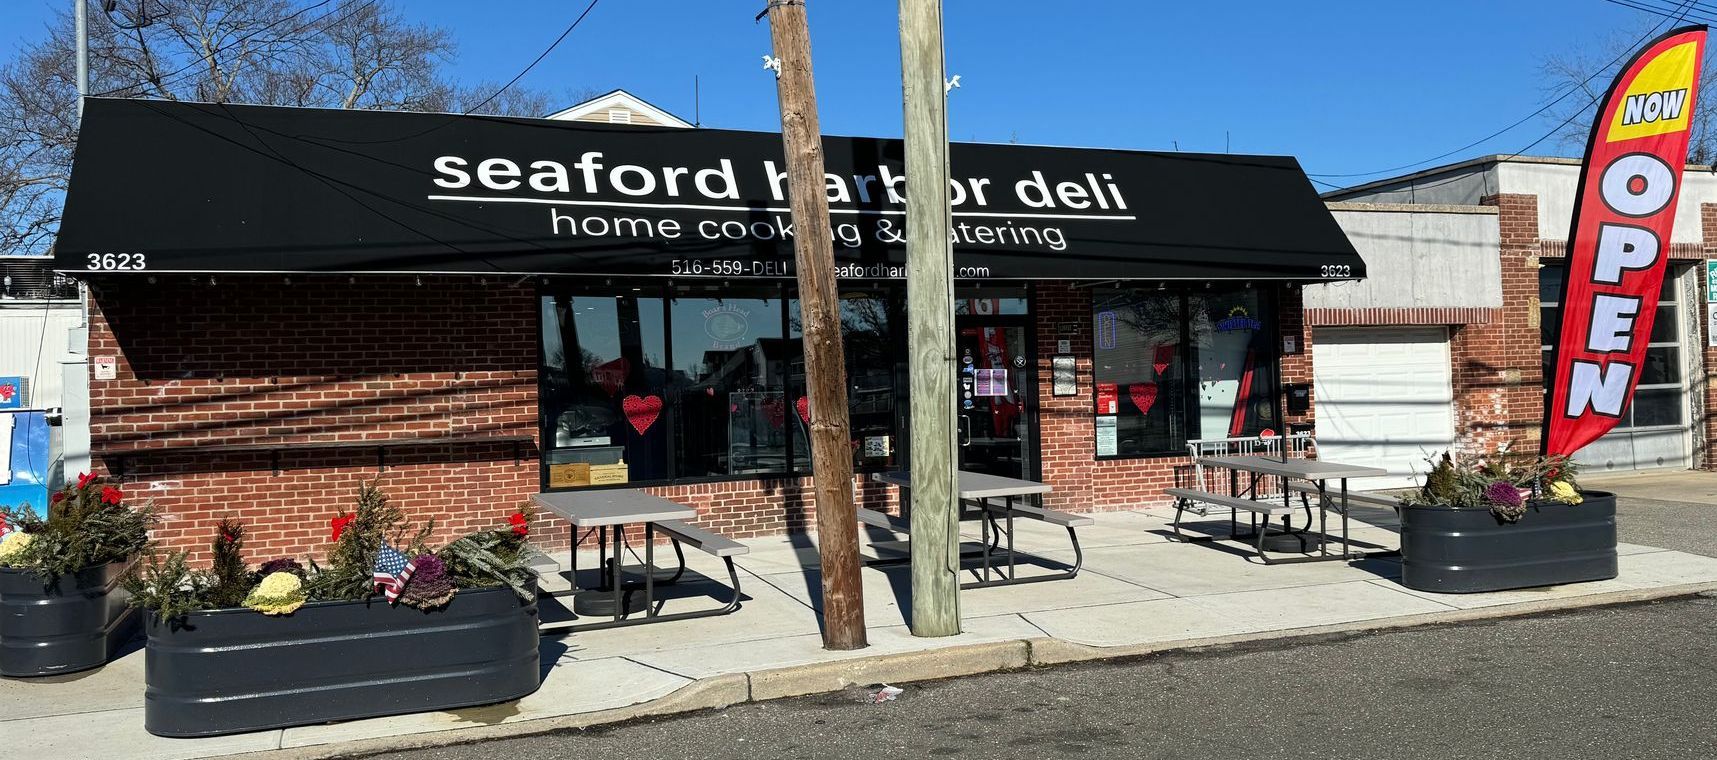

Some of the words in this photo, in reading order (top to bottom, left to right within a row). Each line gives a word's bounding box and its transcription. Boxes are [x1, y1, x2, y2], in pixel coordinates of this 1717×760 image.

[1622, 88, 1688, 126] NOW
[433, 151, 740, 200] seaford
[1015, 170, 1128, 210] deli
[551, 208, 682, 239] home
[699, 214, 862, 248] cookg
[875, 219, 907, 243] &
[951, 220, 1067, 251] atering
[87, 253, 146, 270] 3623
[672, 259, 788, 276] 516-559-DELI
[1320, 265, 1351, 277] 3623
[1564, 152, 1677, 418] OPEN
